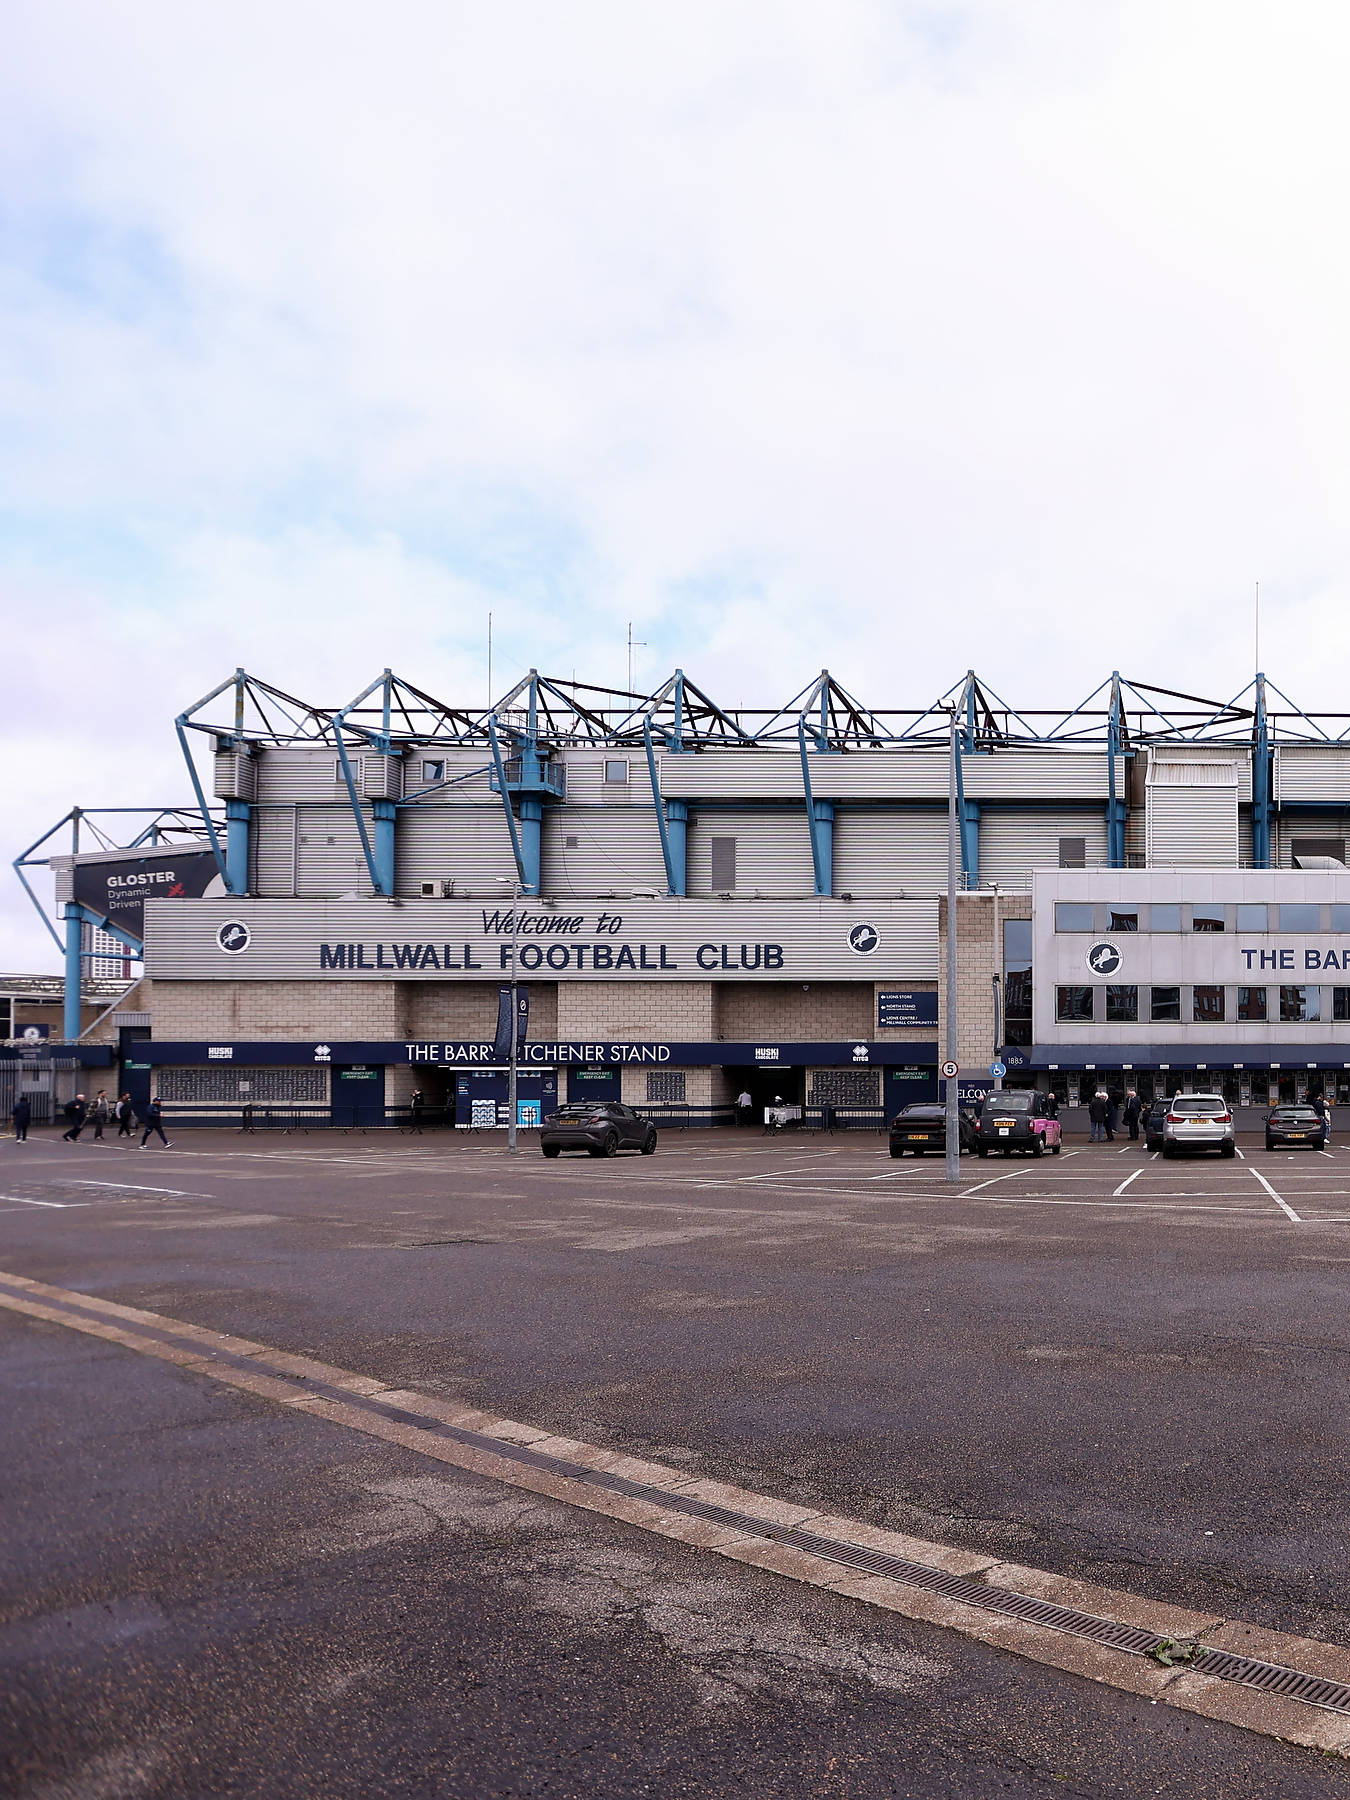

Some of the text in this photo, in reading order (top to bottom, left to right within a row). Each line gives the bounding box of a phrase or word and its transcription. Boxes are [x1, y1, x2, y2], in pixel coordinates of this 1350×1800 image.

[107, 871, 175, 887] GLOSTER
[108, 888, 151, 899] Dynamic
[109, 901, 141, 909] Driven
[482, 909, 623, 934] Welcome to
[320, 944, 784, 970] MILLWALL FOOTBALL CLUB
[1241, 949, 1295, 970] THE
[406, 1045, 439, 1061] THE
[505, 1044, 606, 1060] TCHENER
[610, 1044, 670, 1061] STAND
[947, 1065, 953, 1074] 5
[957, 1089, 994, 1098] ELCO
